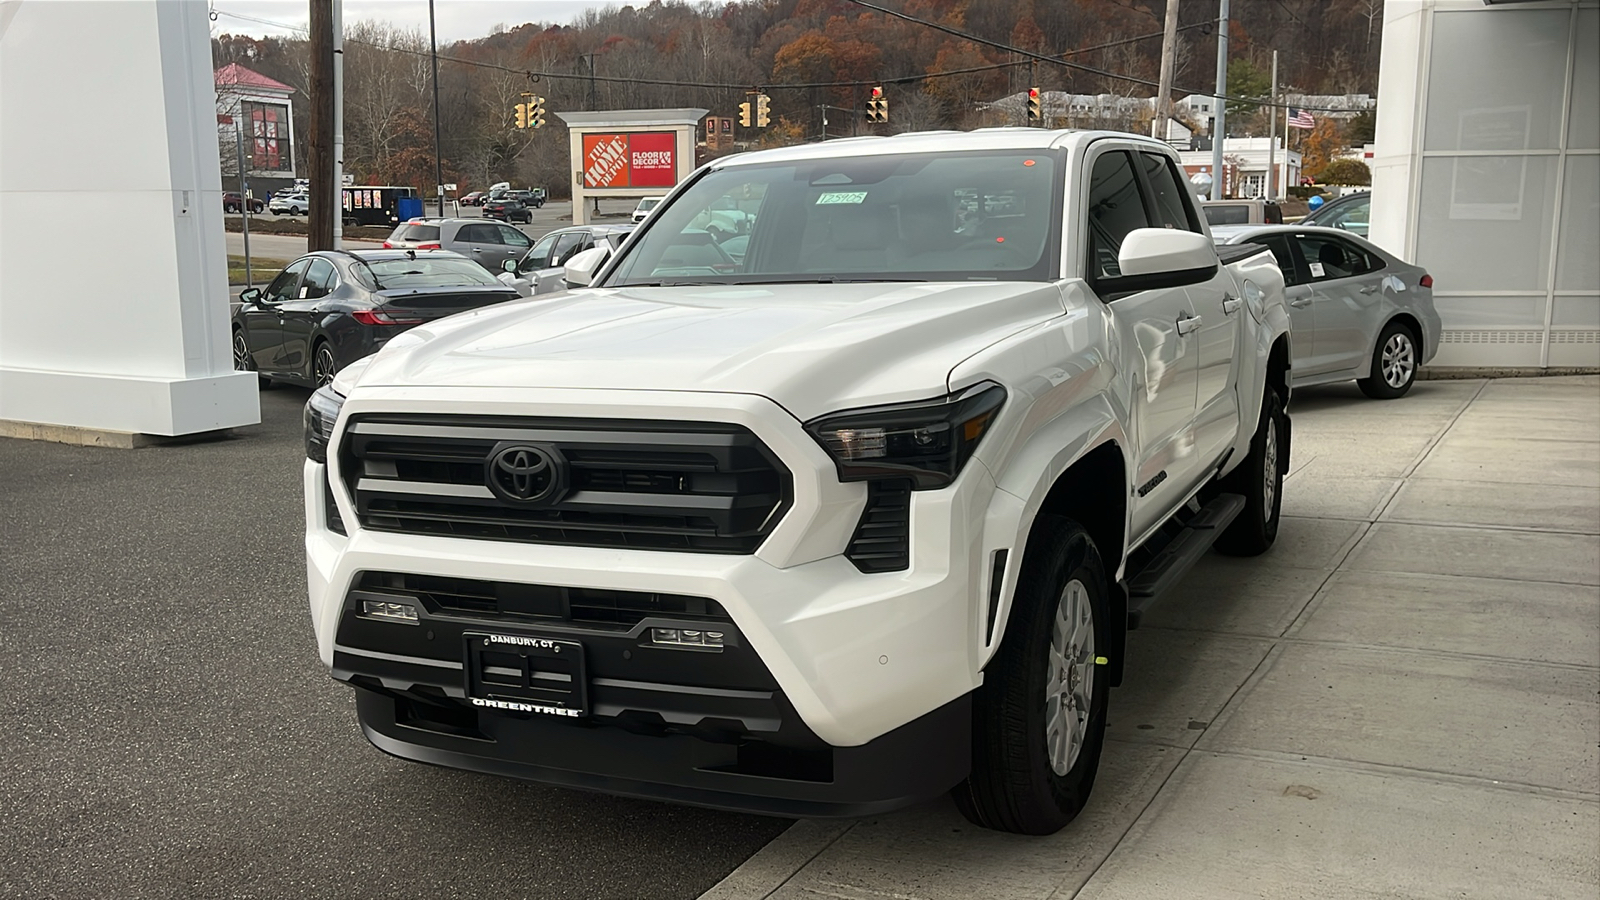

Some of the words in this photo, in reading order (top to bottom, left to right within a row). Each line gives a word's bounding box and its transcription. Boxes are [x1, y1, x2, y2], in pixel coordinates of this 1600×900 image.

[588, 139, 608, 161] THE
[632, 151, 659, 159] FLOOR
[585, 135, 627, 187] HOME
[600, 153, 628, 187] DEPOT
[490, 635, 539, 648] DANBURY,
[540, 640, 554, 648] CT
[472, 699, 579, 717] GREENTREE
